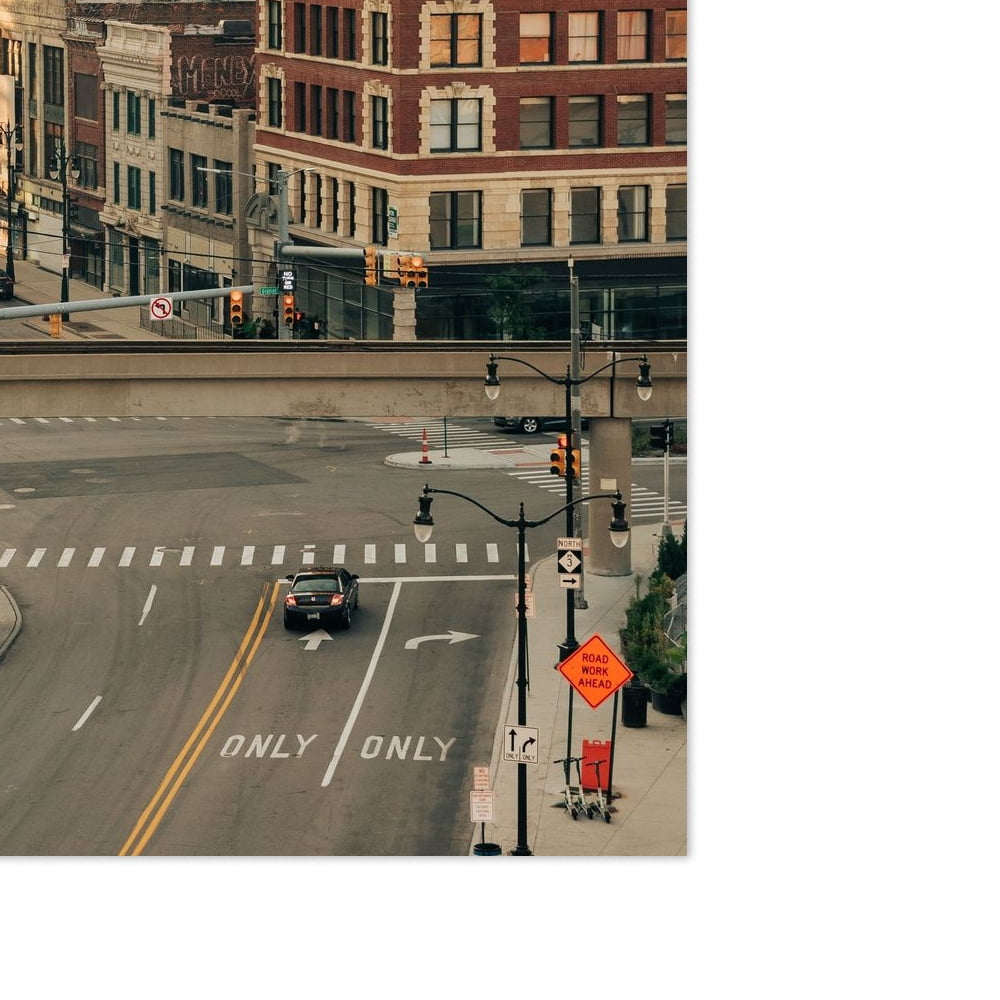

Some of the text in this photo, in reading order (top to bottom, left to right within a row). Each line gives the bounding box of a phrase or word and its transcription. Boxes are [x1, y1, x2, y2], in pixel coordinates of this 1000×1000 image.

[558, 540, 581, 548] NORTH
[566, 558, 573, 568] 3
[582, 653, 609, 664] ROAD
[582, 665, 608, 677] WORK
[578, 678, 612, 689] AHEAD
[219, 734, 319, 758] ONLY
[360, 735, 457, 761] ONLY
